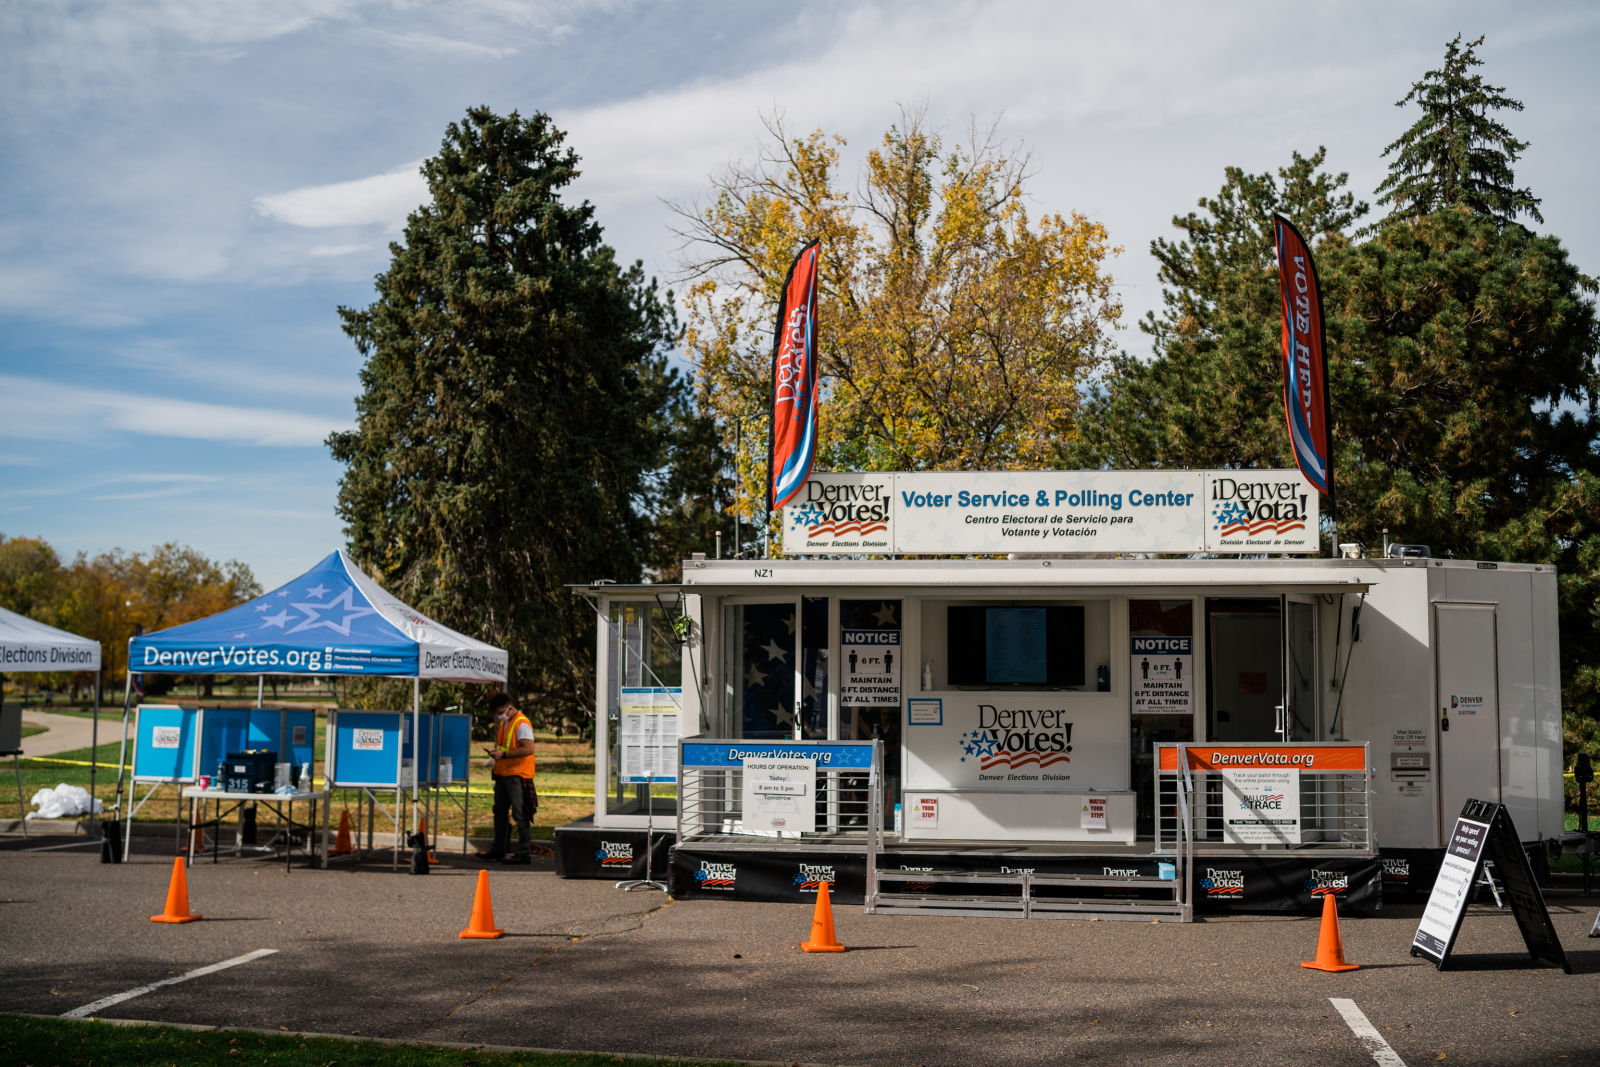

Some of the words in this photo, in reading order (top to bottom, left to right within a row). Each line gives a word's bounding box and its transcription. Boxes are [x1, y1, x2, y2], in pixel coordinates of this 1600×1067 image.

[1293, 255, 1310, 336] VOTE
[806, 480, 884, 502] Denver
[1212, 478, 1300, 500] ¡Denver
[902, 490, 952, 507] Voter
[958, 490, 1030, 507] Service
[1036, 490, 1050, 507] &
[1055, 490, 1122, 510] Polling
[1128, 490, 1194, 507] Center
[816, 496, 890, 522] Votes!
[1240, 494, 1308, 520] Vota!
[965, 514, 1000, 524] Centro
[1002, 514, 1048, 524] Electoral
[1050, 514, 1064, 524] de
[1066, 514, 1108, 524] Servicio
[1110, 516, 1134, 526] para
[1002, 528, 1040, 536] Votante
[1042, 530, 1050, 538] y
[1052, 528, 1097, 536] Votación
[754, 568, 772, 578] NZ1
[845, 632, 898, 644] NOTICE
[1135, 640, 1189, 650] NOTICE
[0, 646, 48, 663] lections
[50, 647, 92, 664] Division
[144, 646, 322, 672] DenverVotes.org
[425, 652, 452, 669] Denver
[452, 651, 481, 670] Elections
[482, 656, 505, 676] Division
[977, 705, 1066, 728] Denver
[989, 723, 1073, 752] Votes!
[1211, 752, 1314, 766] DenverVota.org
[228, 778, 248, 789] 315
[1249, 801, 1281, 809] TRACE
[601, 841, 631, 850] Denver
[605, 848, 633, 858] Votes!
[700, 861, 734, 872] Denver
[799, 863, 833, 874] Denver
[1382, 858, 1406, 867] enver
[706, 868, 736, 880] Votes!
[804, 871, 836, 882] Votes!
[1103, 867, 1138, 877] Denver
[1207, 868, 1242, 879] Denver
[1311, 869, 1346, 880] Denver
[1212, 875, 1244, 888] Votes!
[1316, 875, 1348, 888] Votes!
